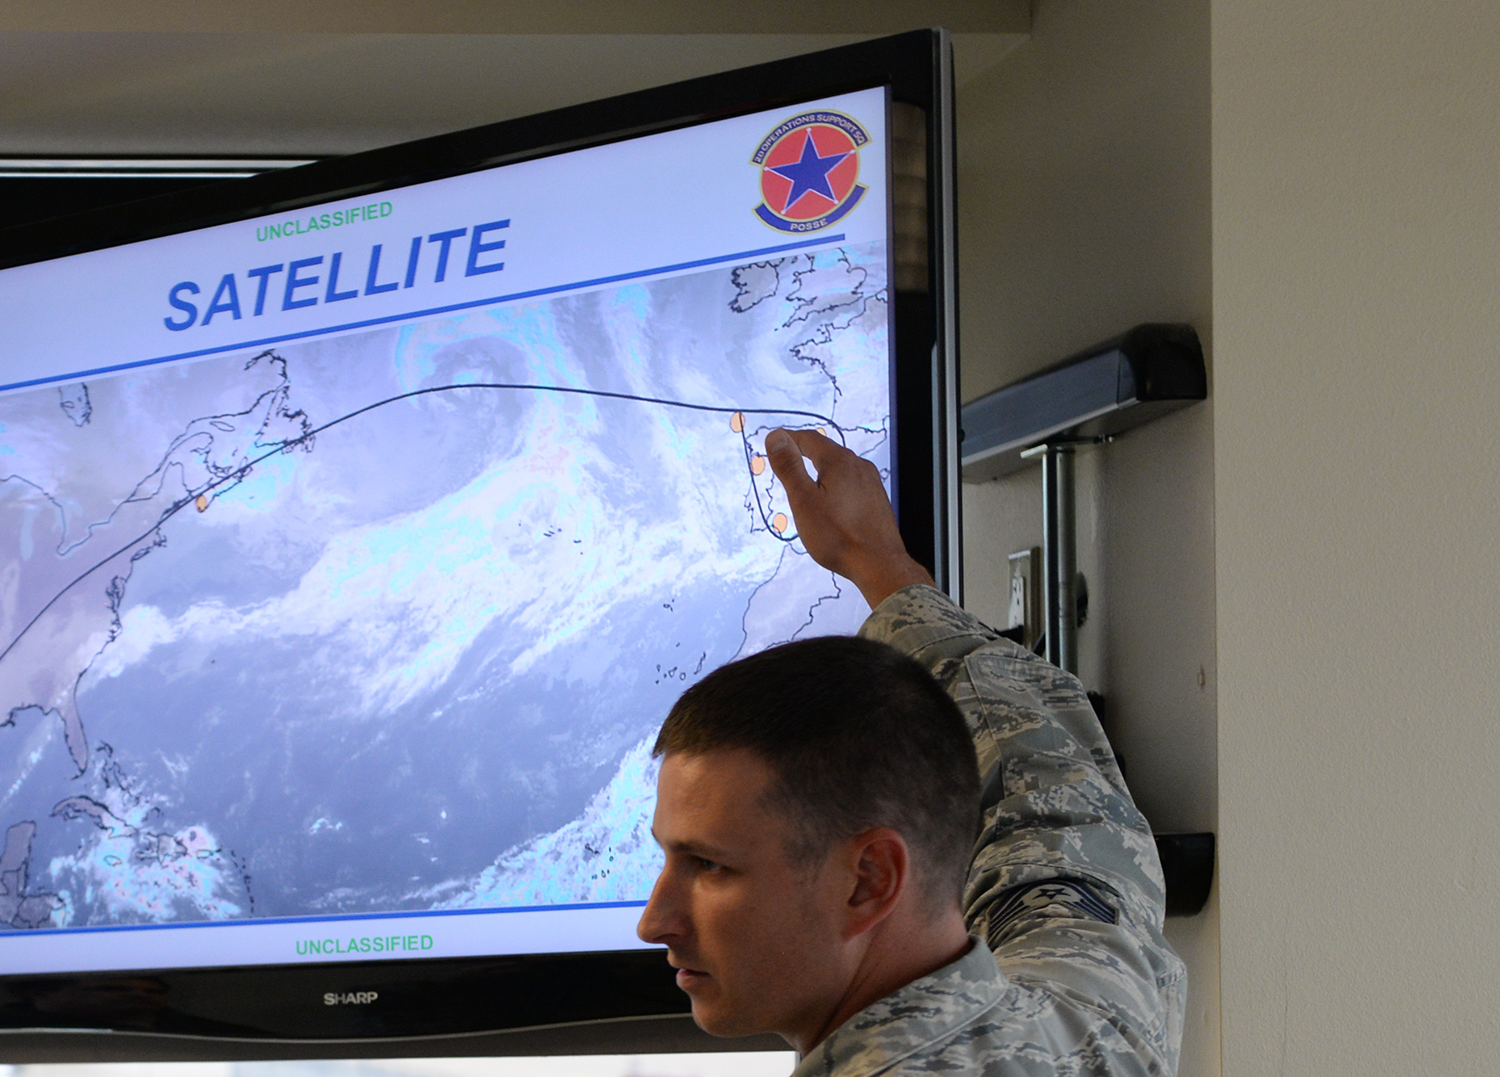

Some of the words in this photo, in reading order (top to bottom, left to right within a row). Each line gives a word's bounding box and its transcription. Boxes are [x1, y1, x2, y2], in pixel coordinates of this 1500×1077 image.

[762, 114, 815, 152] OPERATIONS
[816, 114, 857, 132] SUPPORT
[853, 130, 866, 144] SQ
[256, 201, 393, 242] UNCLASSIFIED
[790, 217, 828, 231] POSSE
[163, 218, 511, 332] SATELLITE
[296, 935, 433, 955] UNCLASSIFIED
[323, 991, 379, 1006] SHARP
